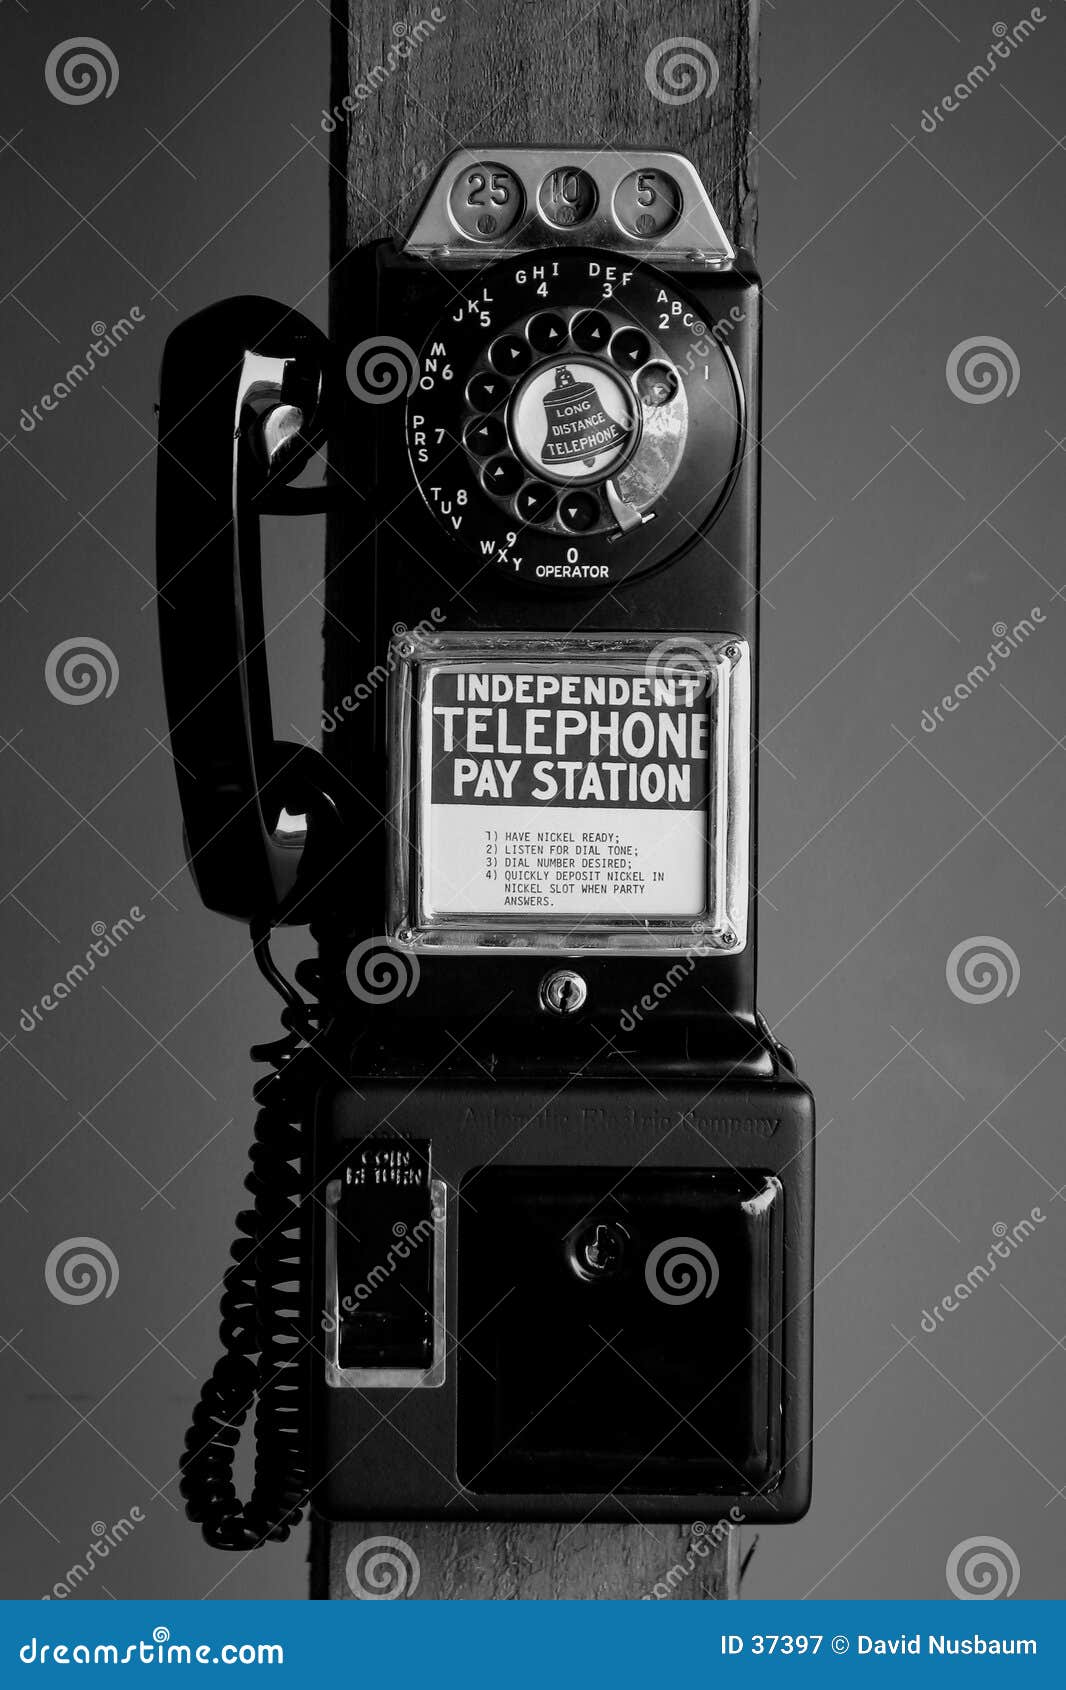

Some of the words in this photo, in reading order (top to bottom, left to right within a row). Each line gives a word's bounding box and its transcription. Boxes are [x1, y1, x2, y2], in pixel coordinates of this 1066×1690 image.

[465, 172, 511, 207] 25
[549, 172, 579, 203] 10
[636, 174, 657, 207] 5
[536, 281, 549, 297] 4
[602, 282, 613, 299] 3
[480, 311, 491, 327] 5
[658, 313, 670, 330] 2
[442, 365, 454, 381] 6
[555, 401, 591, 418] LONG
[551, 412, 606, 437] DISTANCE
[435, 428, 445, 444] 7
[546, 424, 620, 457] TELEPHONE
[456, 489, 468, 506] 8
[506, 531, 517, 548] 9
[535, 565, 609, 578] OPERATOR
[457, 674, 700, 707] INDEPENDENT
[433, 706, 709, 759] TELEPHONE
[453, 757, 522, 798] PAY
[531, 760, 691, 802] STATION
[485, 830, 498, 842] 1)
[505, 831, 531, 842] HAVE
[537, 831, 575, 843] NICKEL
[582, 832, 620, 845] READY;
[486, 843, 498, 853] 2)
[505, 844, 544, 855] LISTEN
[549, 844, 569, 855] FOR
[575, 845, 601, 856] DIAL
[607, 845, 638, 857] TONE;
[486, 856, 498, 868] 3)
[504, 857, 530, 868] DIAL
[537, 857, 576, 868] NUMBER
[581, 858, 632, 870] DESIRED;
[485, 869, 497, 881] 4)
[504, 870, 549, 882] QUICKLY
[556, 870, 601, 881] DEPOSIT
[607, 871, 645, 882] NICKEL
[653, 871, 665, 882] IN
[504, 883, 542, 894] NICKEL
[549, 883, 575, 894] SLOT
[581, 883, 607, 894] WHEN
[613, 884, 645, 894] PARTY
[504, 896, 555, 907] ANSWERS.
